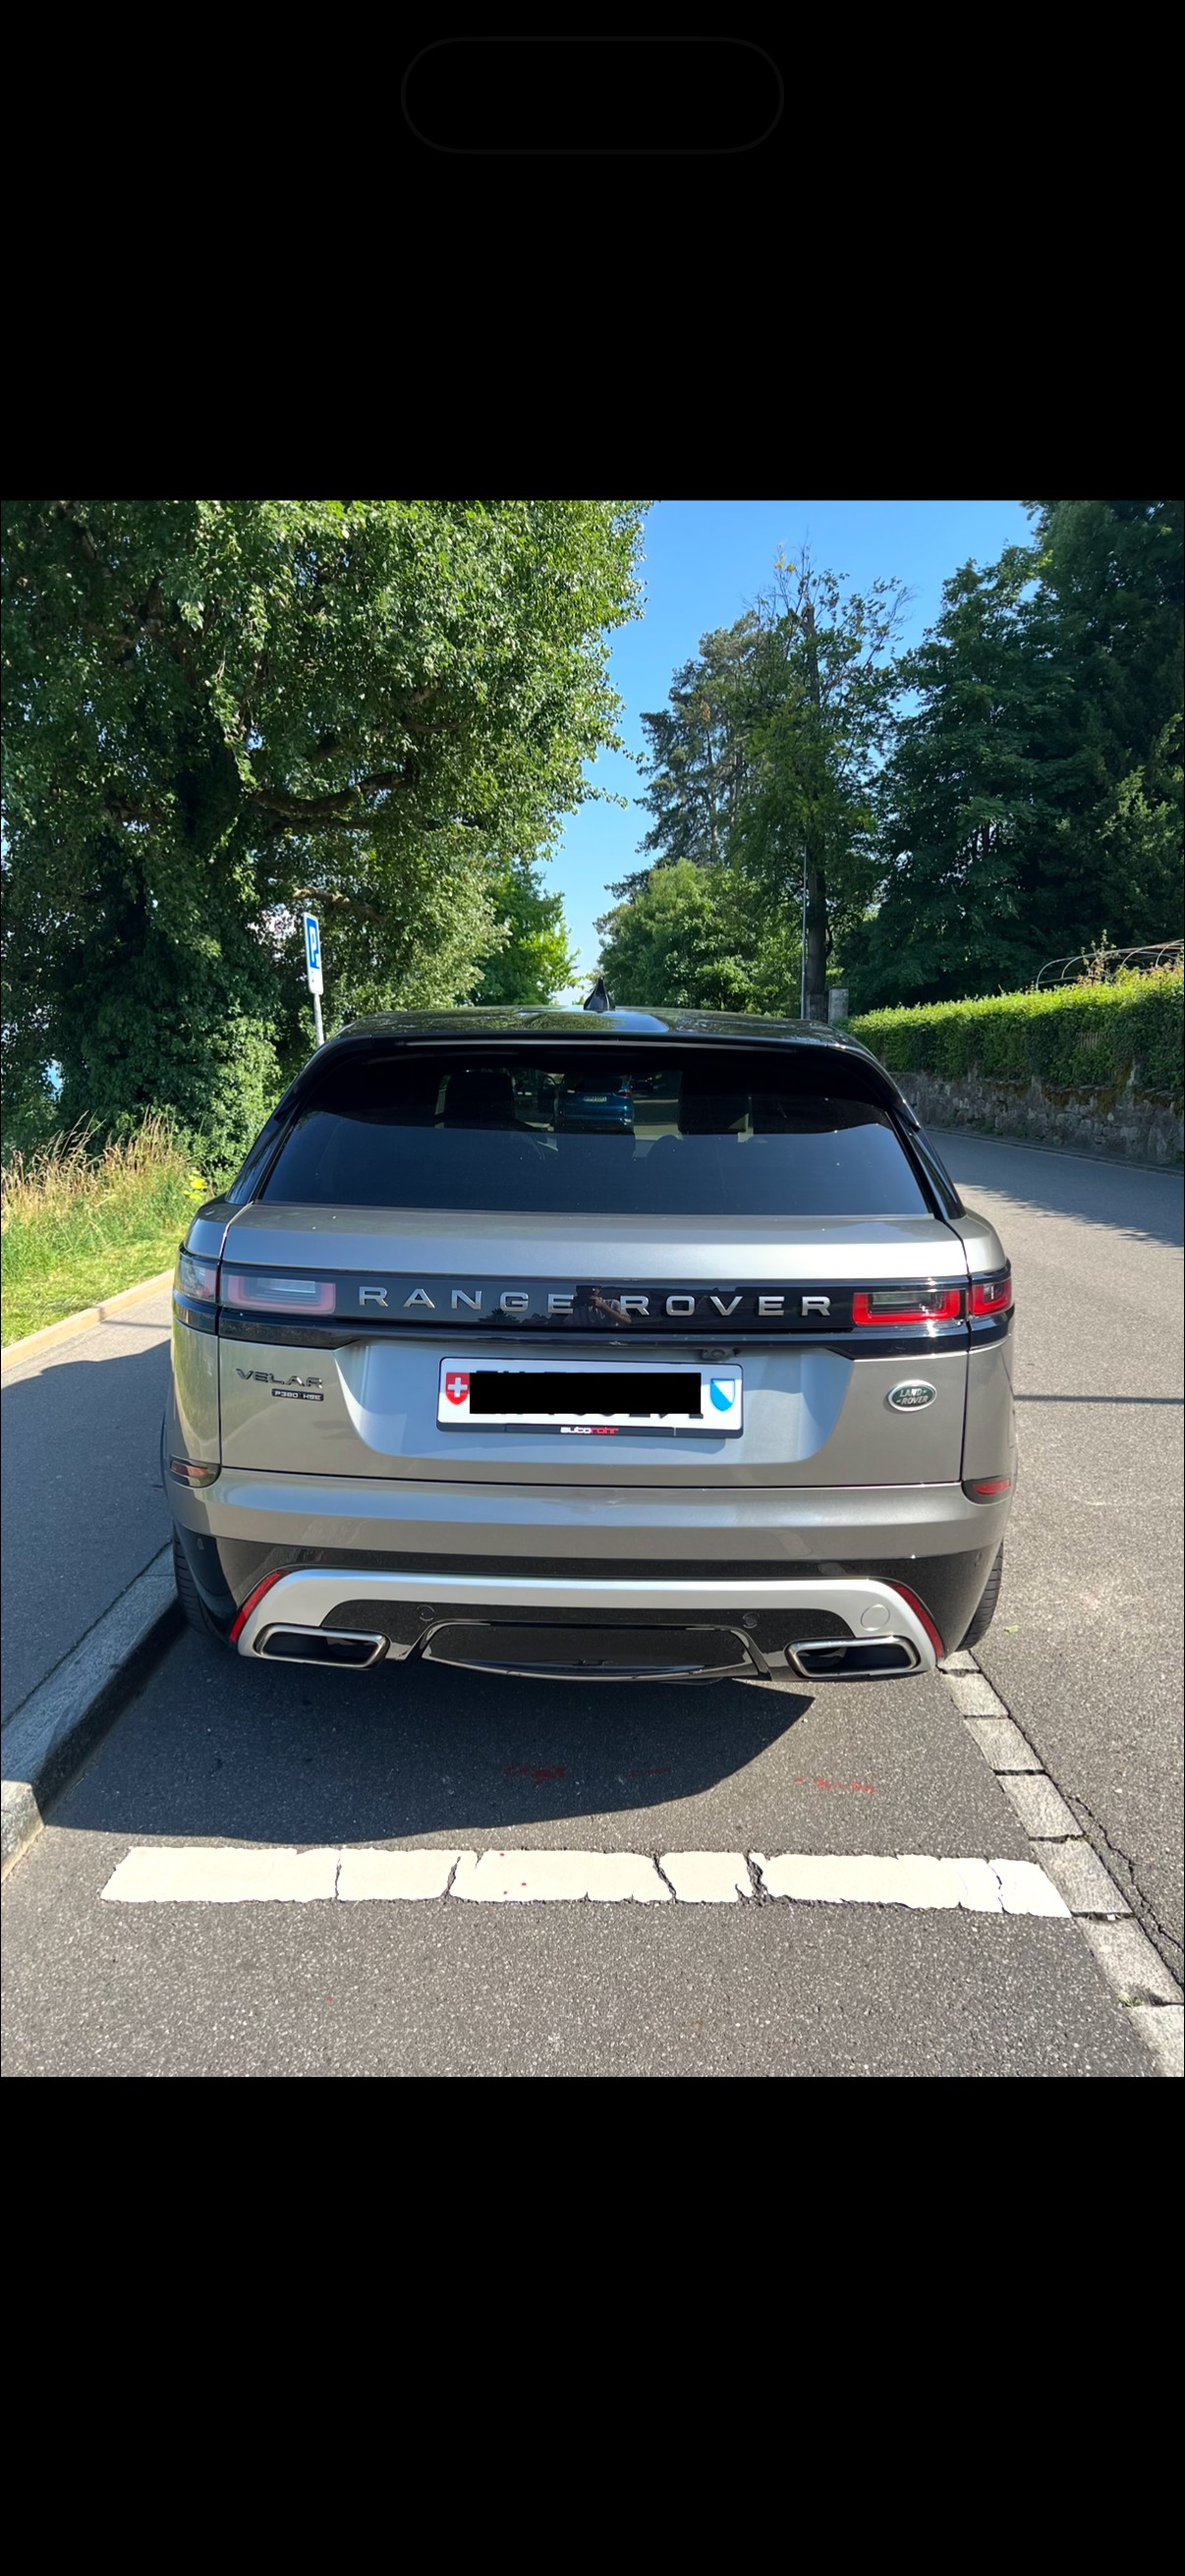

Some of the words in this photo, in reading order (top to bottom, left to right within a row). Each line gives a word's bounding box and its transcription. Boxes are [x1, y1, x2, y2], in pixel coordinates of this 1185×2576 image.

[359, 1286, 574, 1314] RANGE
[620, 1295, 830, 1316] ROVER
[236, 1369, 323, 1388] VELAR
[899, 1387, 923, 1397] LAND
[900, 1395, 929, 1405] ROVER
